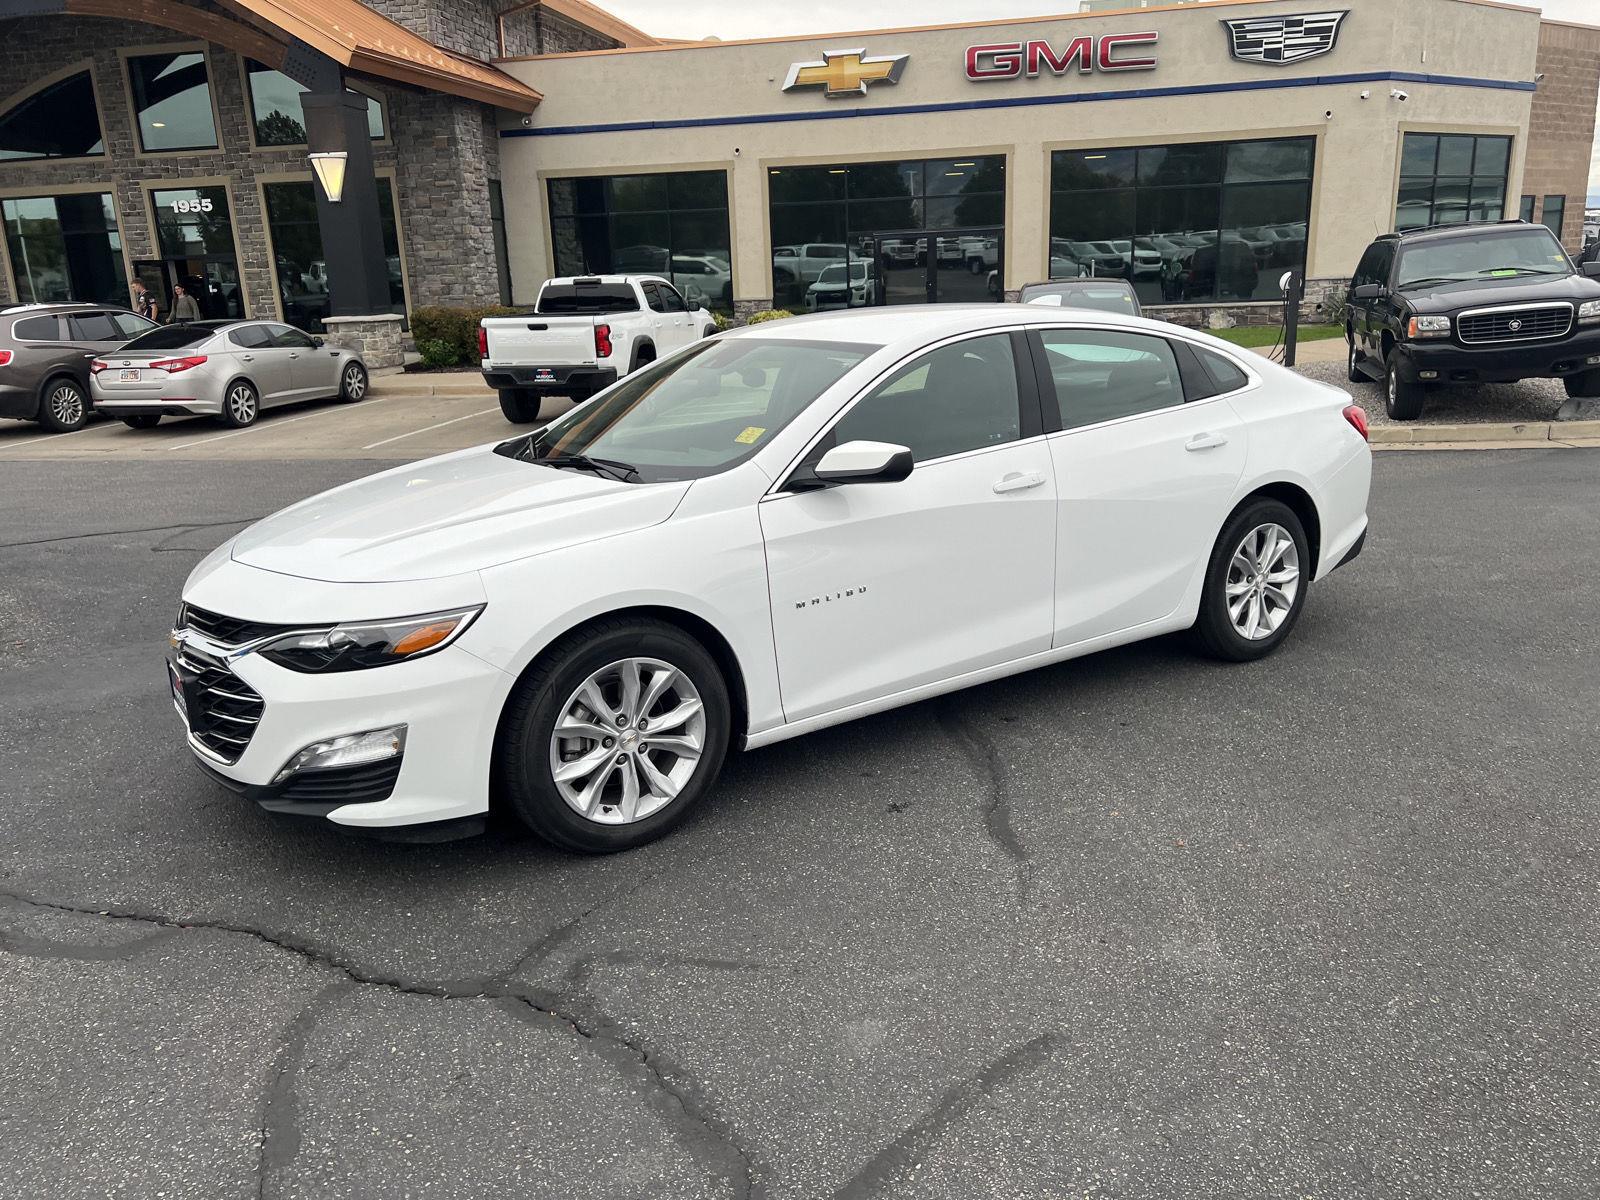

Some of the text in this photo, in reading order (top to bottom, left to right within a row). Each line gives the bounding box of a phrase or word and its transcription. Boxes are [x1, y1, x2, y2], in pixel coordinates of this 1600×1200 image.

[965, 31, 1159, 81] GMC
[170, 198, 213, 213] 1955
[795, 586, 867, 609] MALIBU
